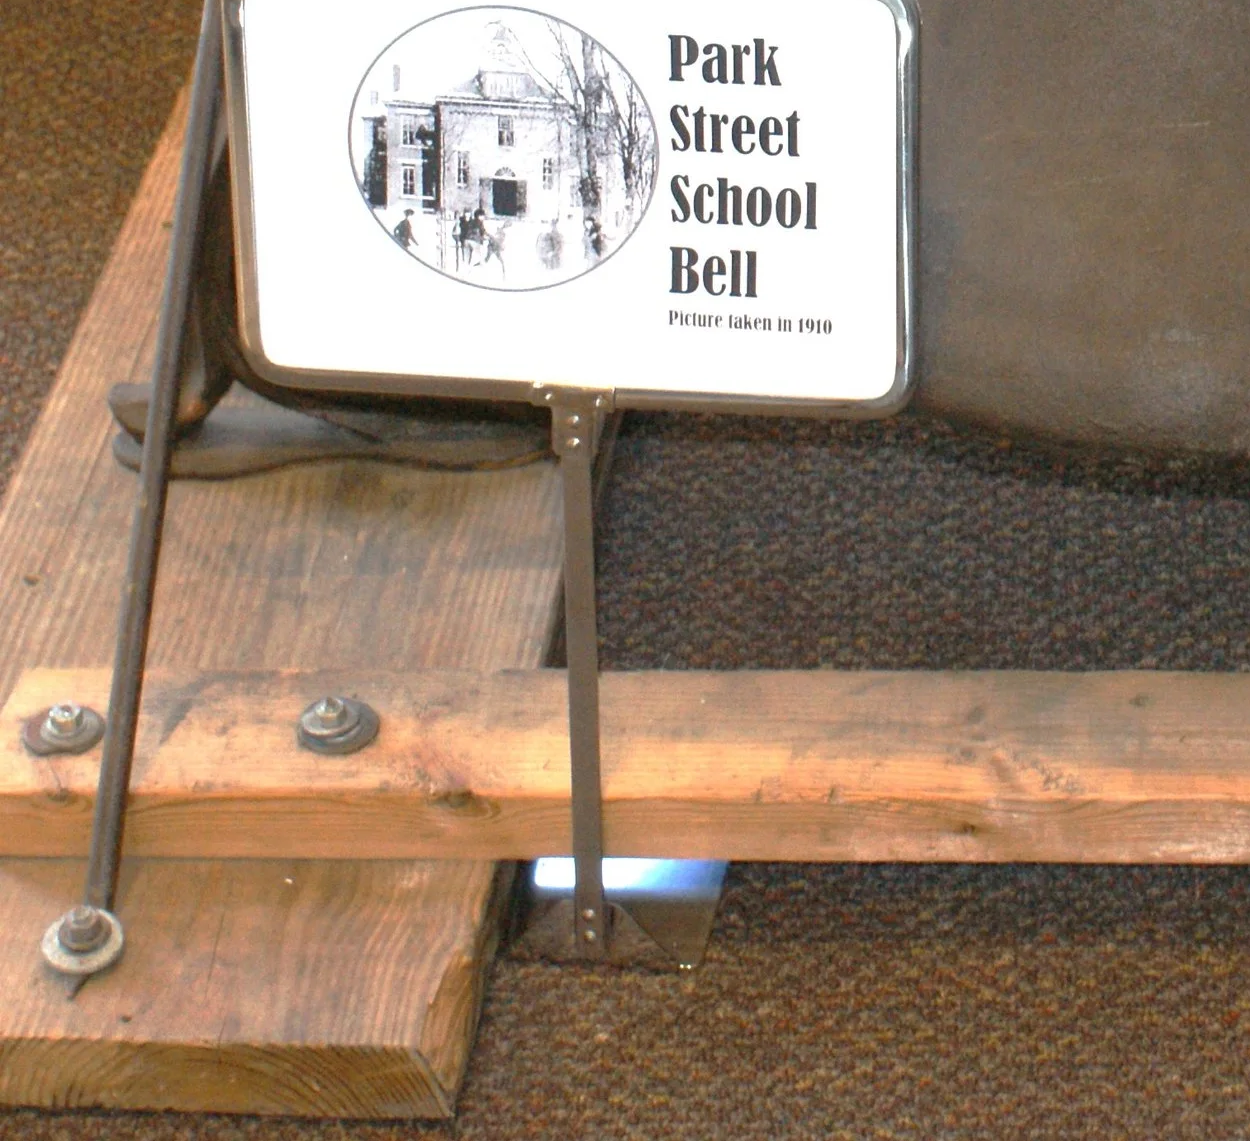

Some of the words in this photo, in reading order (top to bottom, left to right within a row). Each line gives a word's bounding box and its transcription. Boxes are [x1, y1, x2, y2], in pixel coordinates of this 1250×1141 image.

[667, 34, 782, 86] Park
[669, 104, 801, 157] Street
[670, 175, 817, 230] School
[669, 246, 758, 298] Bell
[668, 310, 723, 328] Picture
[728, 313, 772, 332] taken
[777, 316, 792, 333] in
[798, 317, 833, 335] 1910
